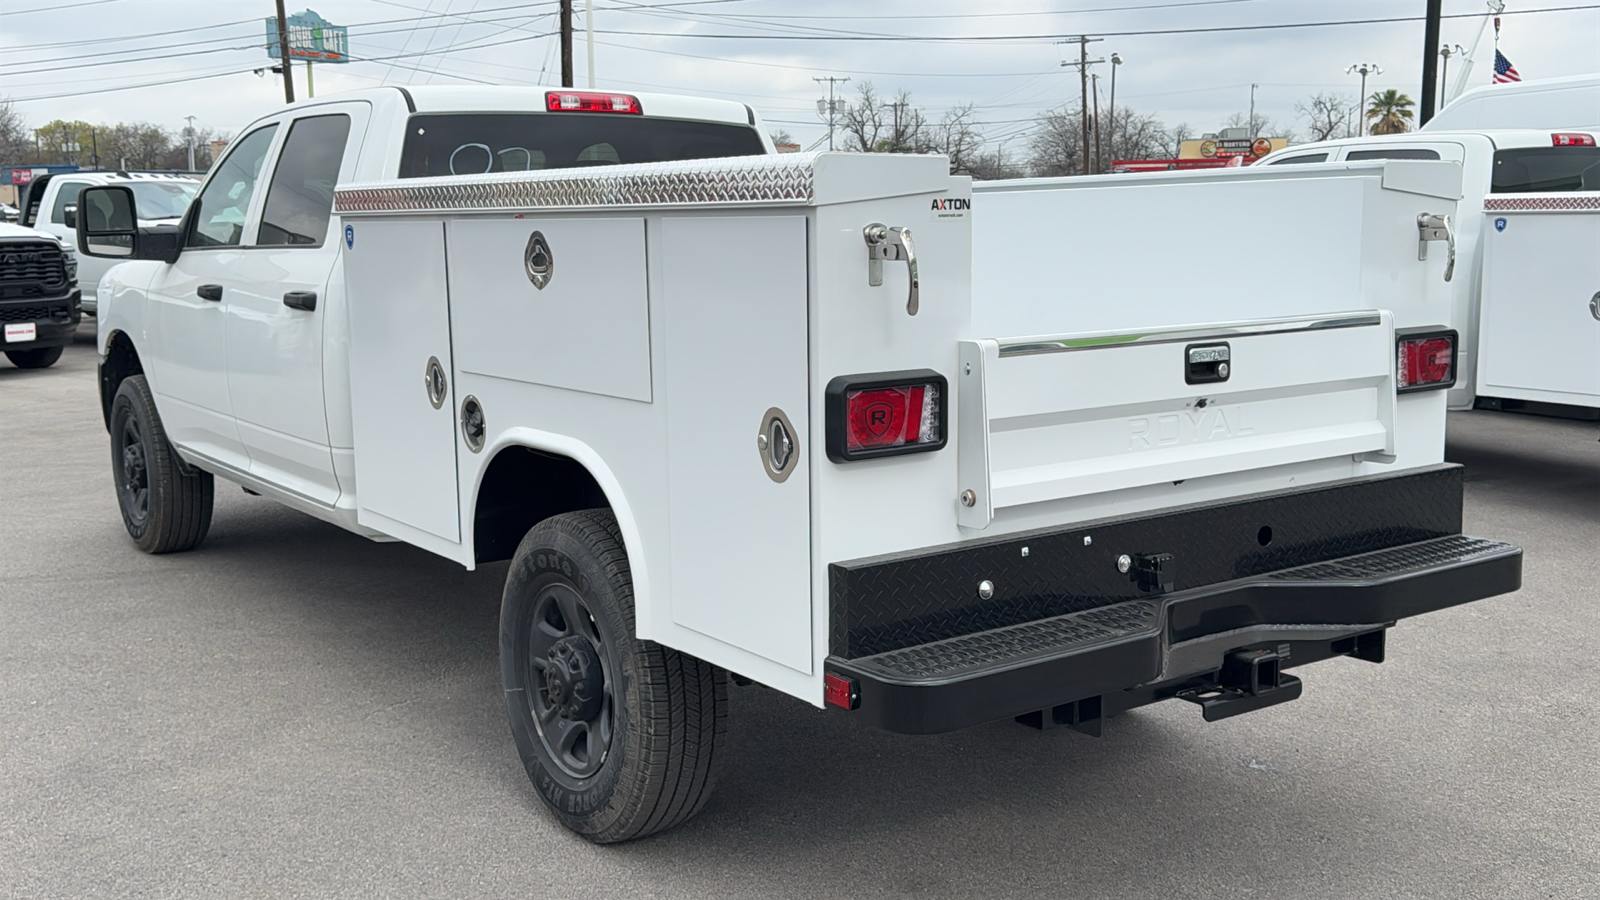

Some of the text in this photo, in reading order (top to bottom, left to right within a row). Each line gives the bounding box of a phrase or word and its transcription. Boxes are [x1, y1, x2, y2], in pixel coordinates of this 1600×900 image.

[931, 198, 971, 211] AXTON
[871, 410, 886, 426] R
[1127, 406, 1254, 451] ROYAL
